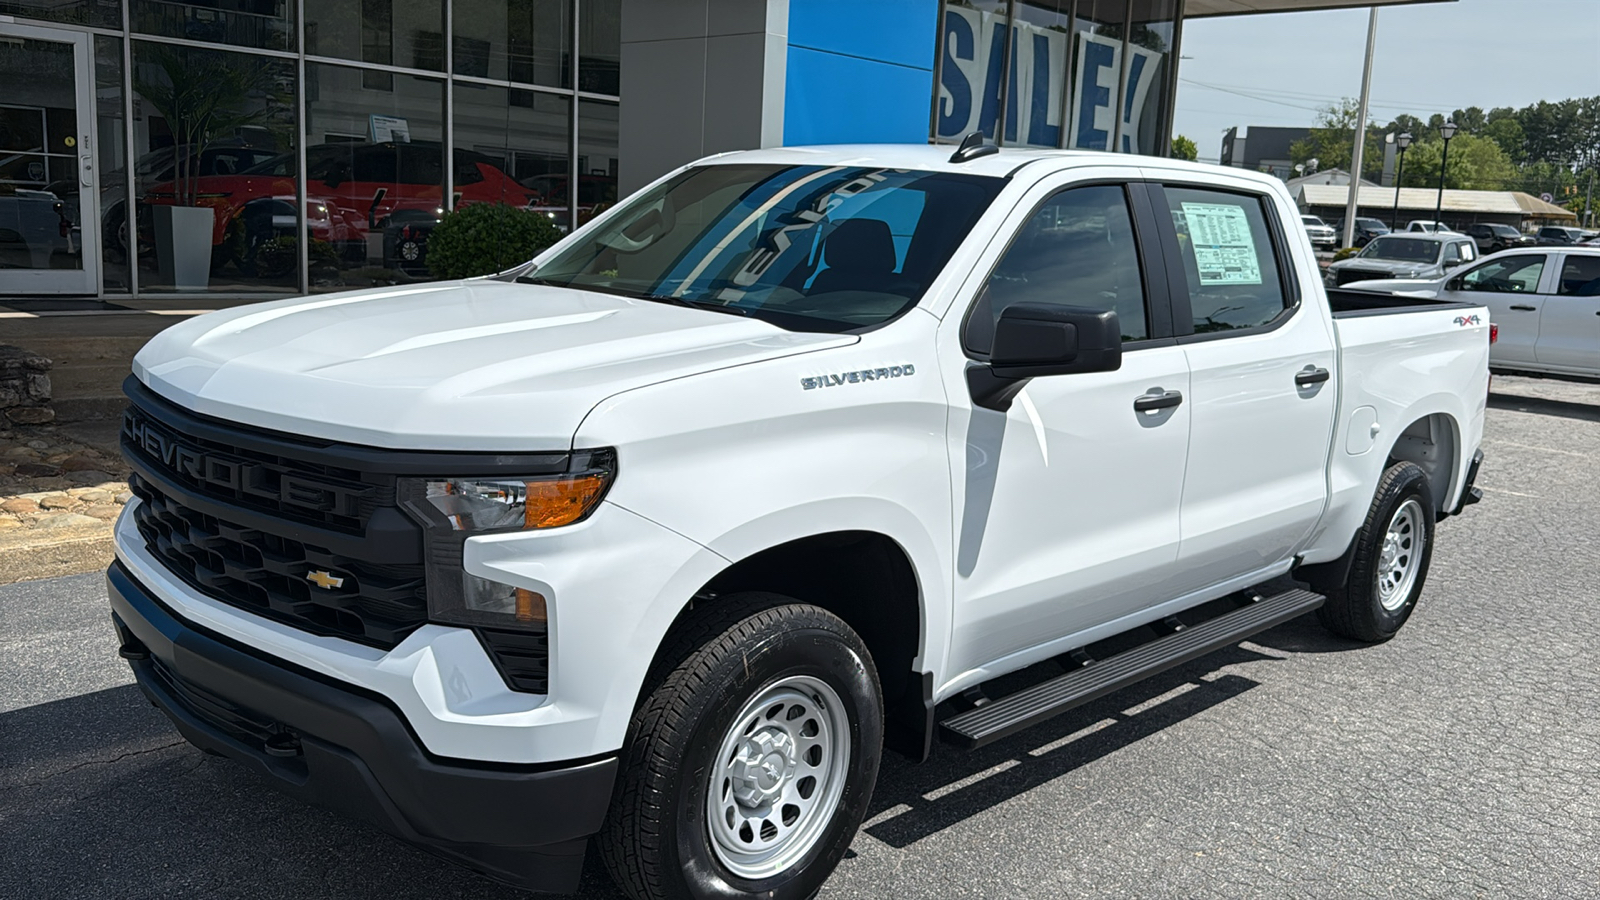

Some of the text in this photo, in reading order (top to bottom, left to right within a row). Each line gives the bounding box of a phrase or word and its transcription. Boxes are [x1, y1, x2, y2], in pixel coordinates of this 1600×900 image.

[938, 11, 1147, 153] SALE!
[800, 364, 915, 391] SILVERADO
[123, 413, 375, 517] CHEVROLET
